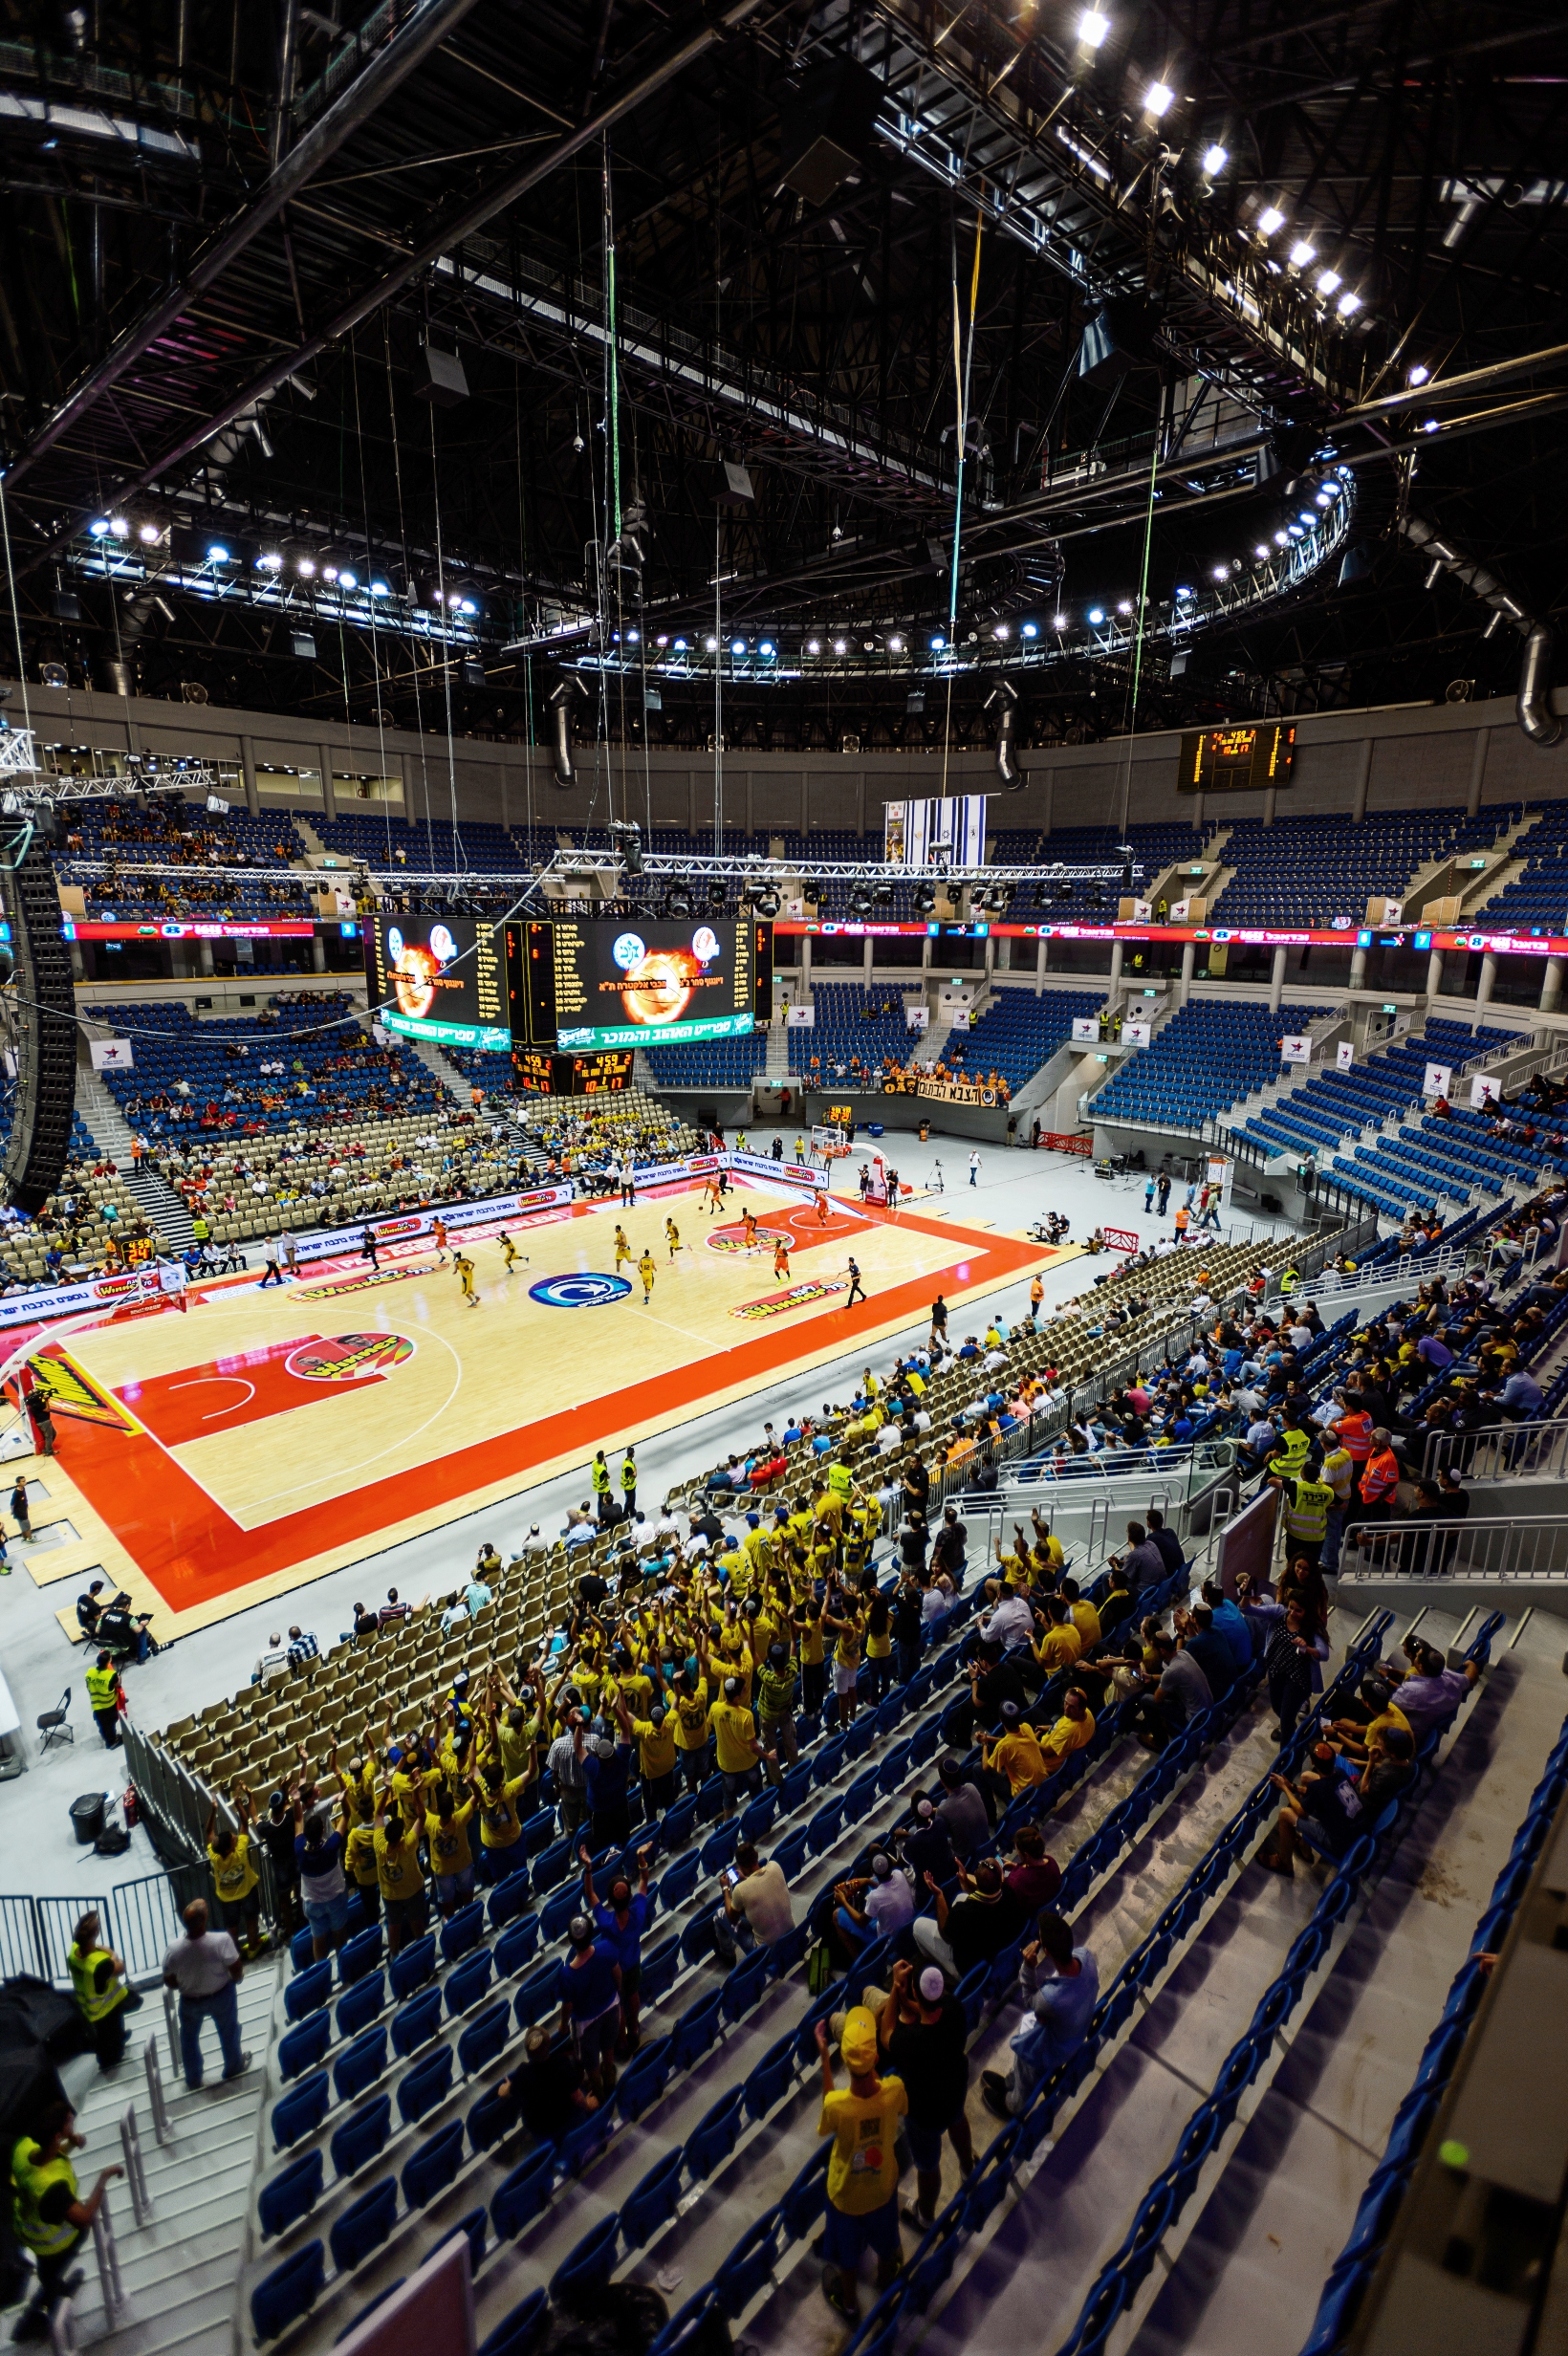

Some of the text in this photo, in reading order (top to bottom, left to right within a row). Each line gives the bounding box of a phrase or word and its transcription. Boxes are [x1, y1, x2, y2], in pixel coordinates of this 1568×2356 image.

[1361, 933, 1367, 943] 6
[1420, 934, 1426, 944] 7
[599, 982, 616, 991] ת"א
[617, 981, 648, 991] אלקטרה
[437, 1027, 476, 1041] ספרייט
[652, 1025, 692, 1040] האהוב
[694, 1020, 731, 1036] ספרייט
[557, 1027, 595, 1045] Sprite
[600, 1029, 650, 1044] והמוכר
[575, 1059, 583, 1071] 2
[623, 1054, 631, 1065] 2
[522, 1077, 531, 1088] 10
[540, 1080, 550, 1092] 17
[585, 1080, 597, 1093] 10
[612, 1077, 621, 1089] 17
[949, 1086, 979, 1102] הצבא
[521, 1197, 546, 1207] Winner
[476, 1206, 496, 1215] ברכבת
[379, 1226, 408, 1236] Winner
[324, 1237, 347, 1248] ברכבת
[338, 1250, 391, 1270] PAS
[461, 1212, 562, 1241] JERUSALEM
[128, 1248, 148, 1263] 24
[365, 1266, 435, 1281] ליגת סל
[305, 1272, 407, 1299] Winner
[820, 1281, 849, 1291] סל
[57, 1292, 90, 1303] נוסעים
[742, 1287, 827, 1318] Winner
[22, 1299, 54, 1312] ברכבת
[302, 1335, 401, 1377] Winner
